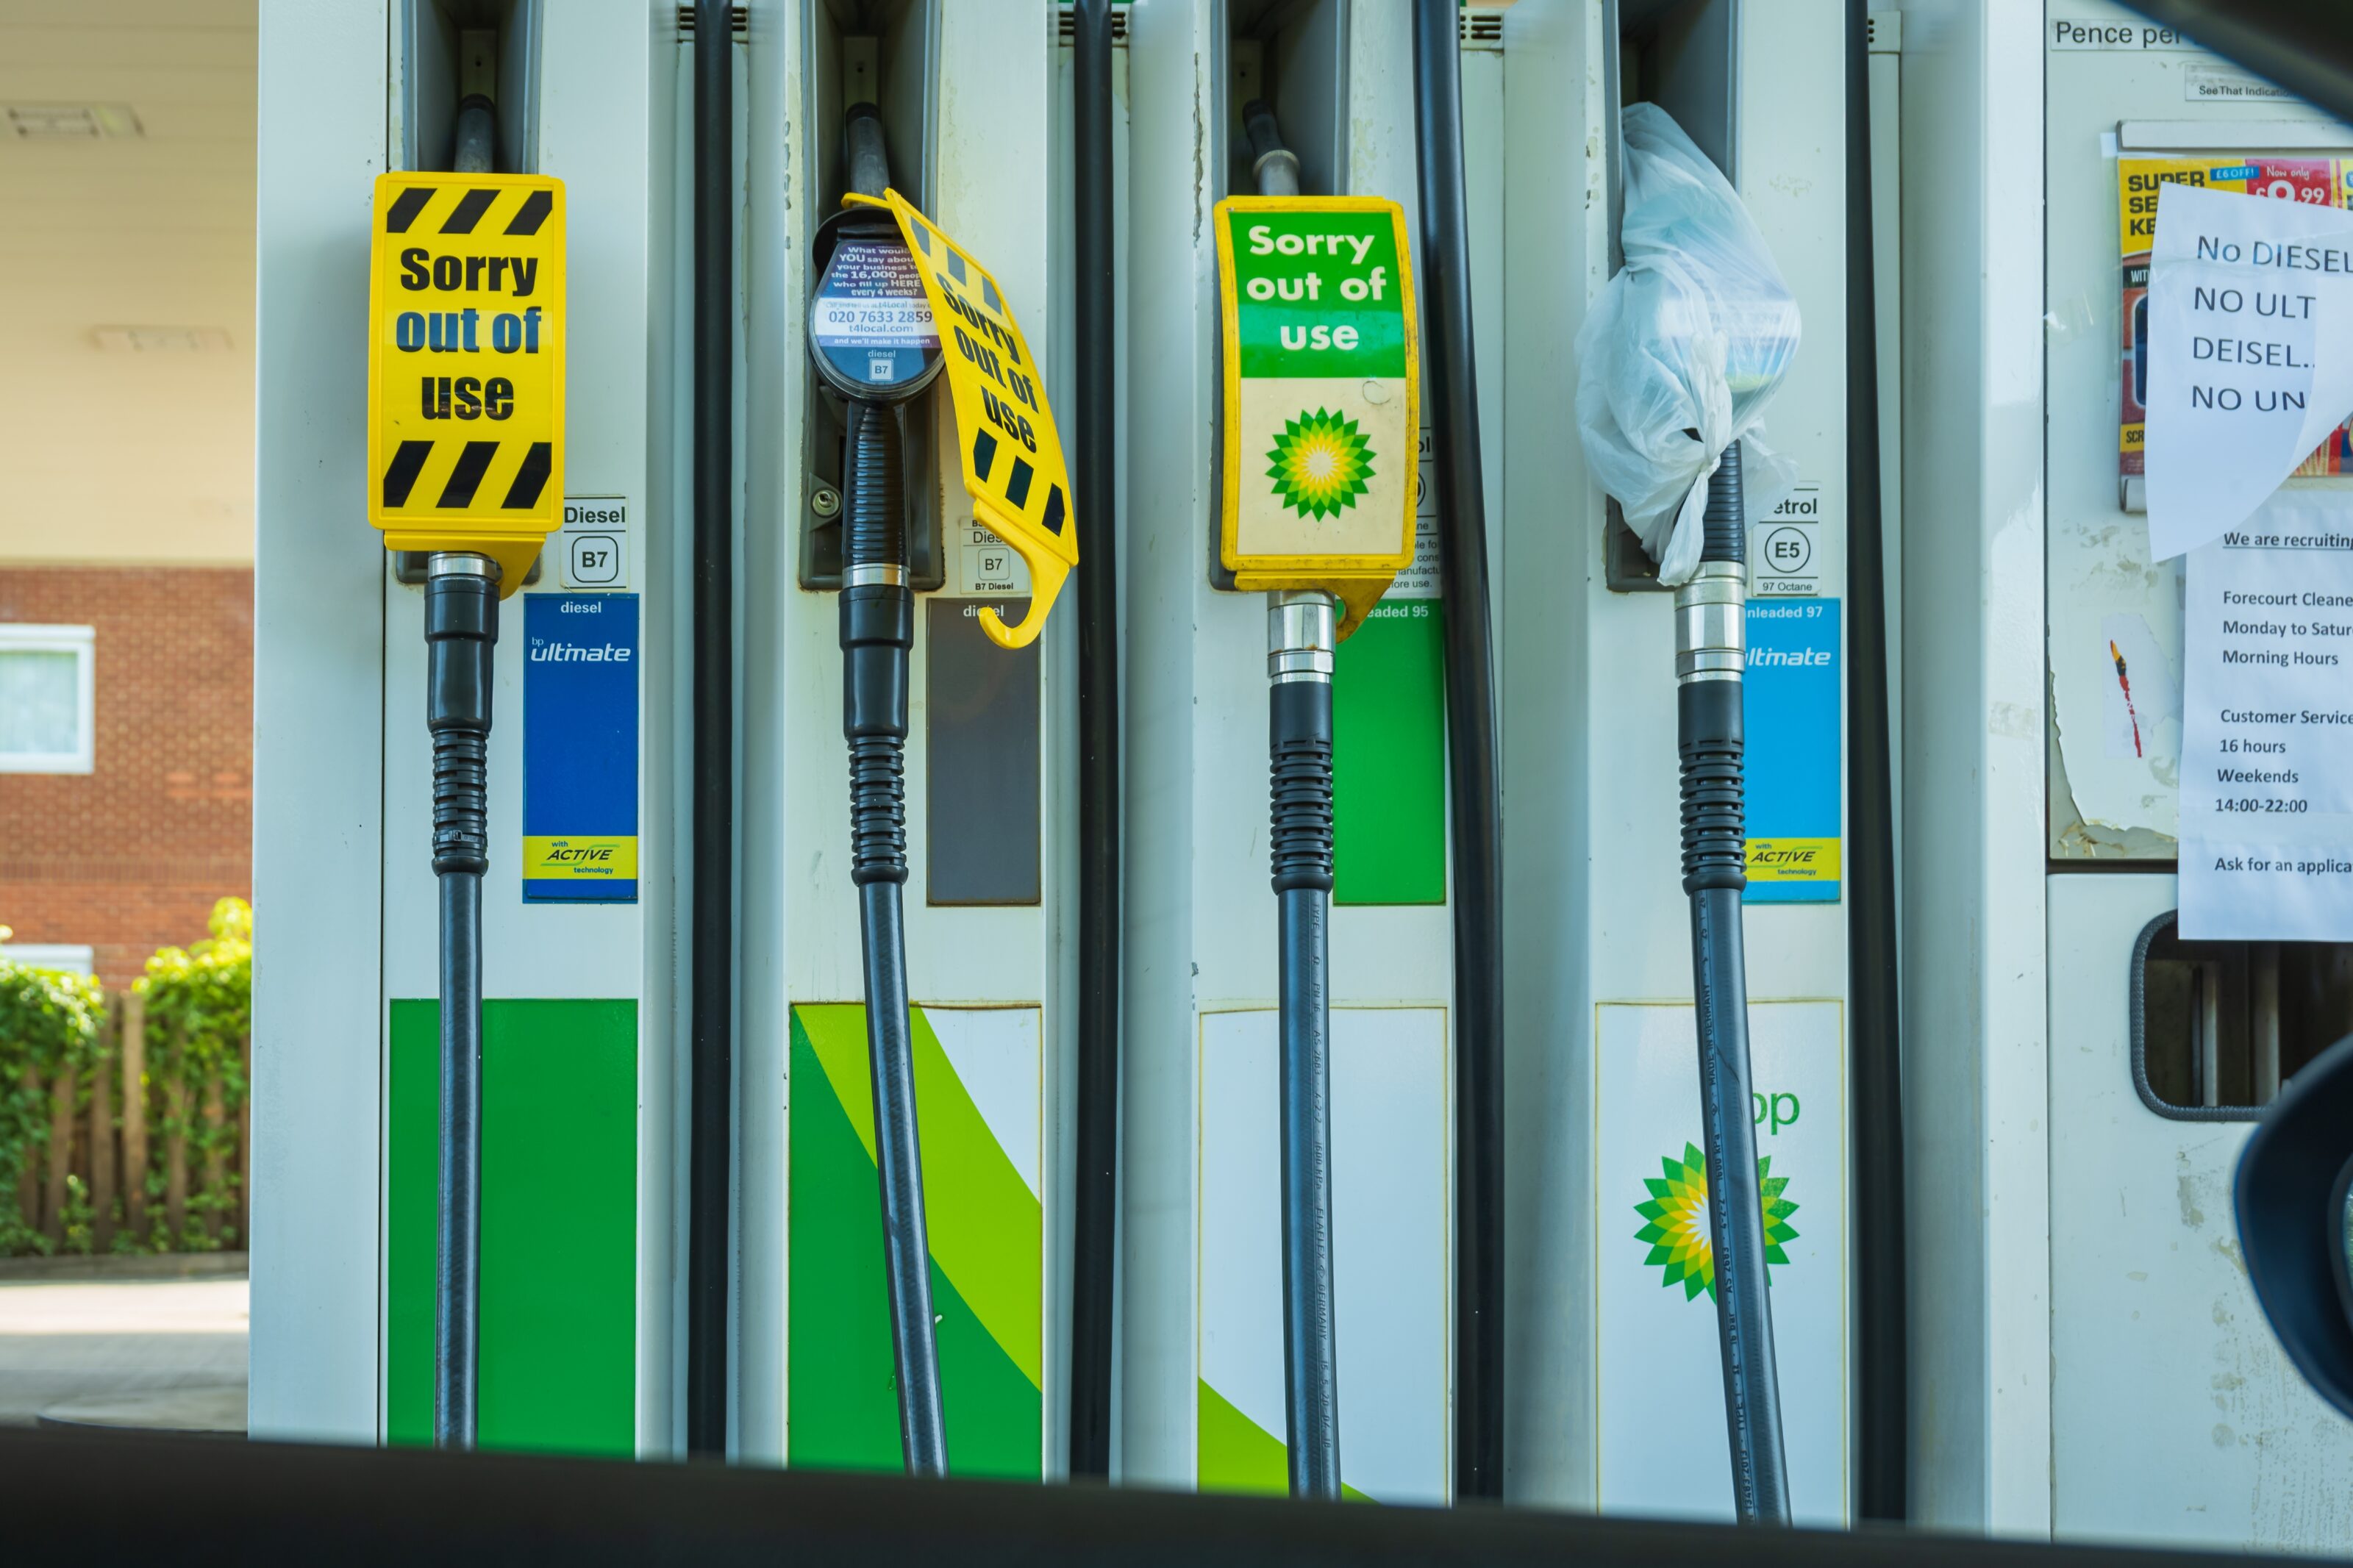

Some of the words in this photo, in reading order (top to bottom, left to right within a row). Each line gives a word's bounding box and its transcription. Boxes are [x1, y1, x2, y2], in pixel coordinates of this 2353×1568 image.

[2056, 21, 2133, 44] Pence
[2199, 85, 2218, 96] See
[2218, 85, 2243, 96] That
[2246, 85, 2295, 98] Indicatio
[2227, 169, 2254, 179] OFF!
[2266, 165, 2288, 177] Now
[2290, 165, 2310, 181] only
[848, 246, 876, 254] What
[1249, 225, 1375, 265] Sorry
[839, 254, 866, 262] YOU
[2197, 235, 2241, 263] No
[2252, 240, 2353, 273] DIESEL
[400, 247, 538, 298] Sorry
[850, 271, 897, 279] 16,000
[890, 279, 921, 287] HERE
[1246, 272, 1322, 301] out
[1339, 265, 1387, 301] of
[851, 288, 876, 298] every
[2194, 286, 2243, 312] NO
[2255, 292, 2317, 319] ULT
[829, 311, 855, 323] 020
[859, 311, 894, 323] 7633
[898, 311, 932, 323] 2859
[935, 272, 1021, 366] Sorry
[396, 307, 480, 354] out
[492, 306, 543, 354] of
[849, 324, 913, 333] t4local.com
[901, 337, 930, 346] happen
[1279, 324, 1359, 351] use
[868, 349, 896, 358] diesel
[874, 365, 888, 374] B7
[954, 324, 1007, 390] out
[1007, 367, 1040, 415] of
[421, 376, 515, 421] use
[2192, 384, 2242, 411] NO
[2254, 390, 2306, 412] UN
[980, 384, 1037, 454] use
[564, 506, 626, 523] Diesel
[1773, 498, 1817, 515] etrol
[973, 531, 1004, 544] Dies
[2224, 531, 2250, 545] We
[2254, 534, 2280, 546] are
[1774, 541, 1801, 559] E5
[581, 551, 609, 568] B7
[985, 558, 1003, 571] B7
[975, 583, 986, 591] B7
[988, 582, 1014, 591] Diesel
[1412, 580, 1433, 589] use.
[1762, 581, 1774, 592] 97
[1777, 581, 1813, 592] Octane
[2223, 590, 2298, 606] Forecourt
[560, 601, 602, 614] diesel
[963, 604, 1004, 617] dieel
[1367, 606, 1409, 618] eaded
[1412, 605, 1429, 617] 95
[1745, 606, 1802, 618] nleaded
[1806, 606, 1824, 618] 97
[2222, 620, 2287, 638] Monday
[2291, 623, 2307, 636] to
[2311, 621, 2353, 637] Satur
[532, 637, 544, 648] bp
[531, 642, 632, 662] ultimate
[1745, 647, 1831, 666] ltimate
[2222, 649, 2290, 667] Morning
[2293, 651, 2339, 666] Hours
[2221, 709, 2297, 723] Customer
[2300, 709, 2353, 725] Service
[2219, 739, 2238, 753] 16
[2243, 738, 2287, 753] hours
[2217, 768, 2299, 784] Weekends
[2215, 798, 2308, 813] 14:00-22:00
[551, 840, 569, 848] with
[546, 849, 614, 861] ACTIVE
[1751, 851, 1816, 862] ACTIVE
[574, 867, 614, 876] technology
[2214, 857, 2244, 872] Ask
[2247, 857, 2271, 872] for
[2275, 861, 2293, 872] an
[2296, 858, 2353, 876] applica
[1702, 984, 1713, 1037] GERMANY
[1706, 1039, 1714, 1050] IN
[1707, 1054, 1716, 1086] MADE
[1713, 1134, 1721, 1154] kPa
[1717, 1198, 1727, 1231] 4-2-2
[1315, 1207, 1325, 1259] ELAFLEX
[1724, 1278, 1733, 1294] AS
[1318, 1284, 1328, 1340] GERMANY
[1727, 1312, 1736, 1331] bar
[1735, 1402, 1745, 1431] TYPE
